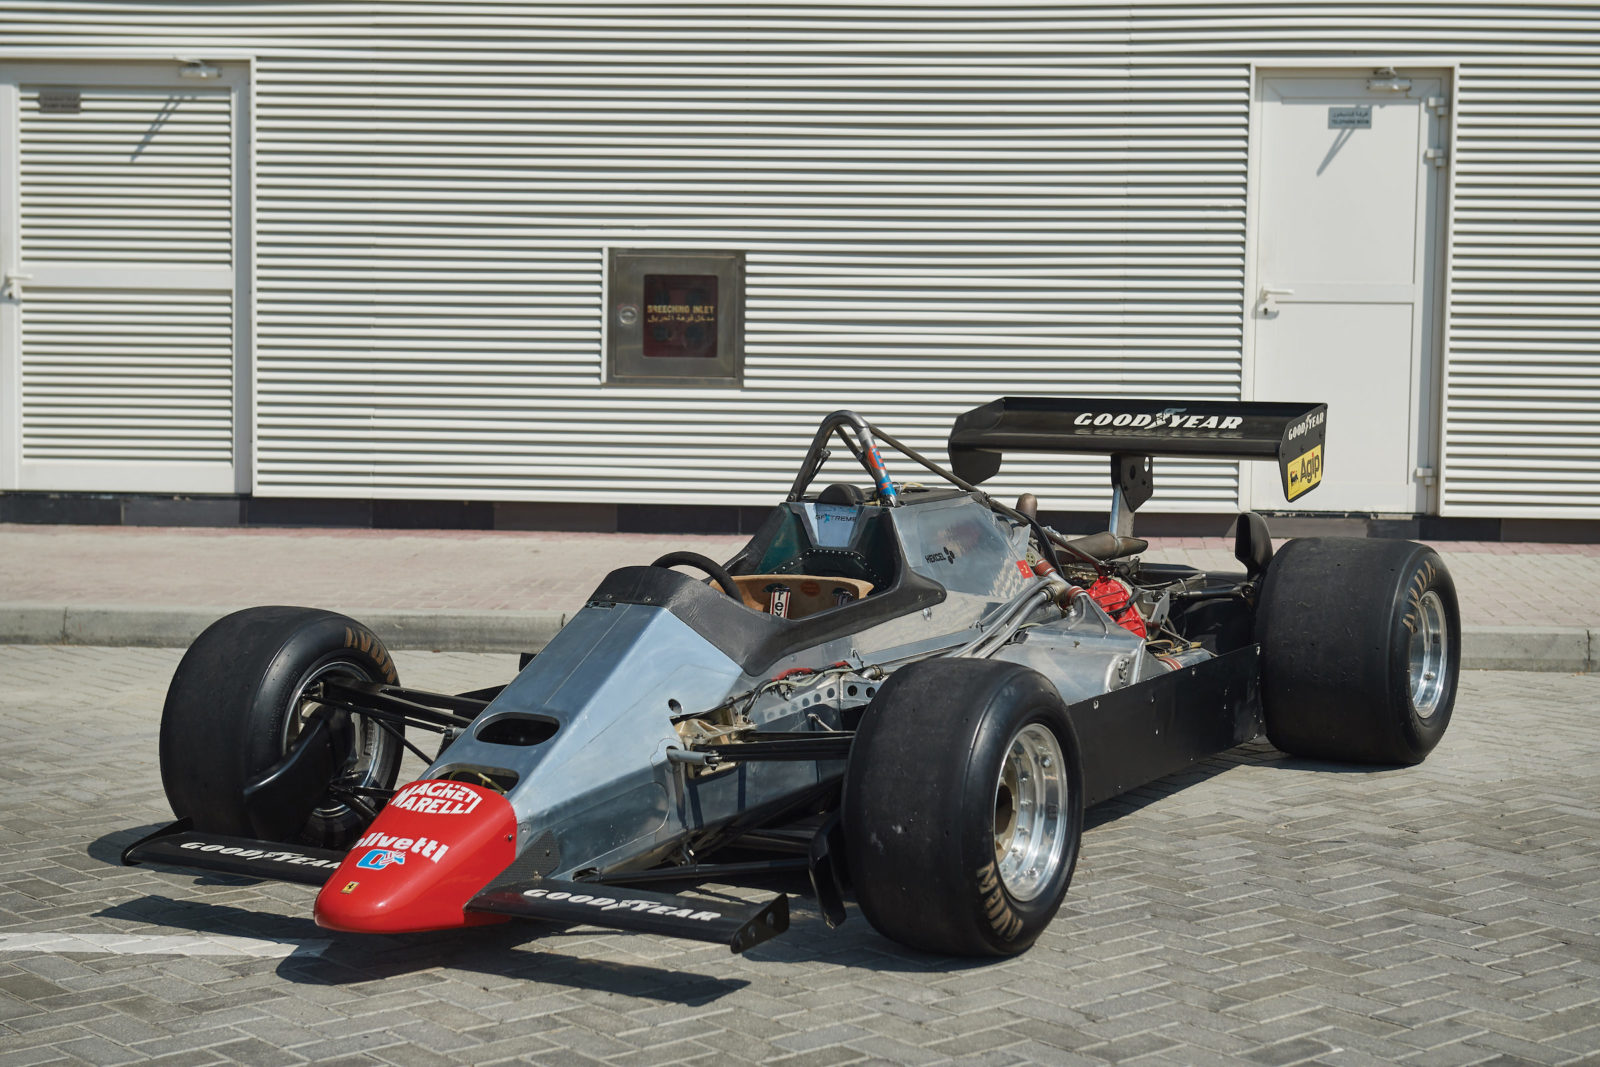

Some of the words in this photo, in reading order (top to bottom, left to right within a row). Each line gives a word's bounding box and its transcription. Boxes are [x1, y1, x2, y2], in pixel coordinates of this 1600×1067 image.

[693, 305, 714, 313] INLET
[1074, 410, 1243, 430] GOODYEAR
[1289, 412, 1324, 441] GOODYEAR
[1300, 452, 1320, 484] Agip
[523, 888, 722, 922] GOODYEAR
